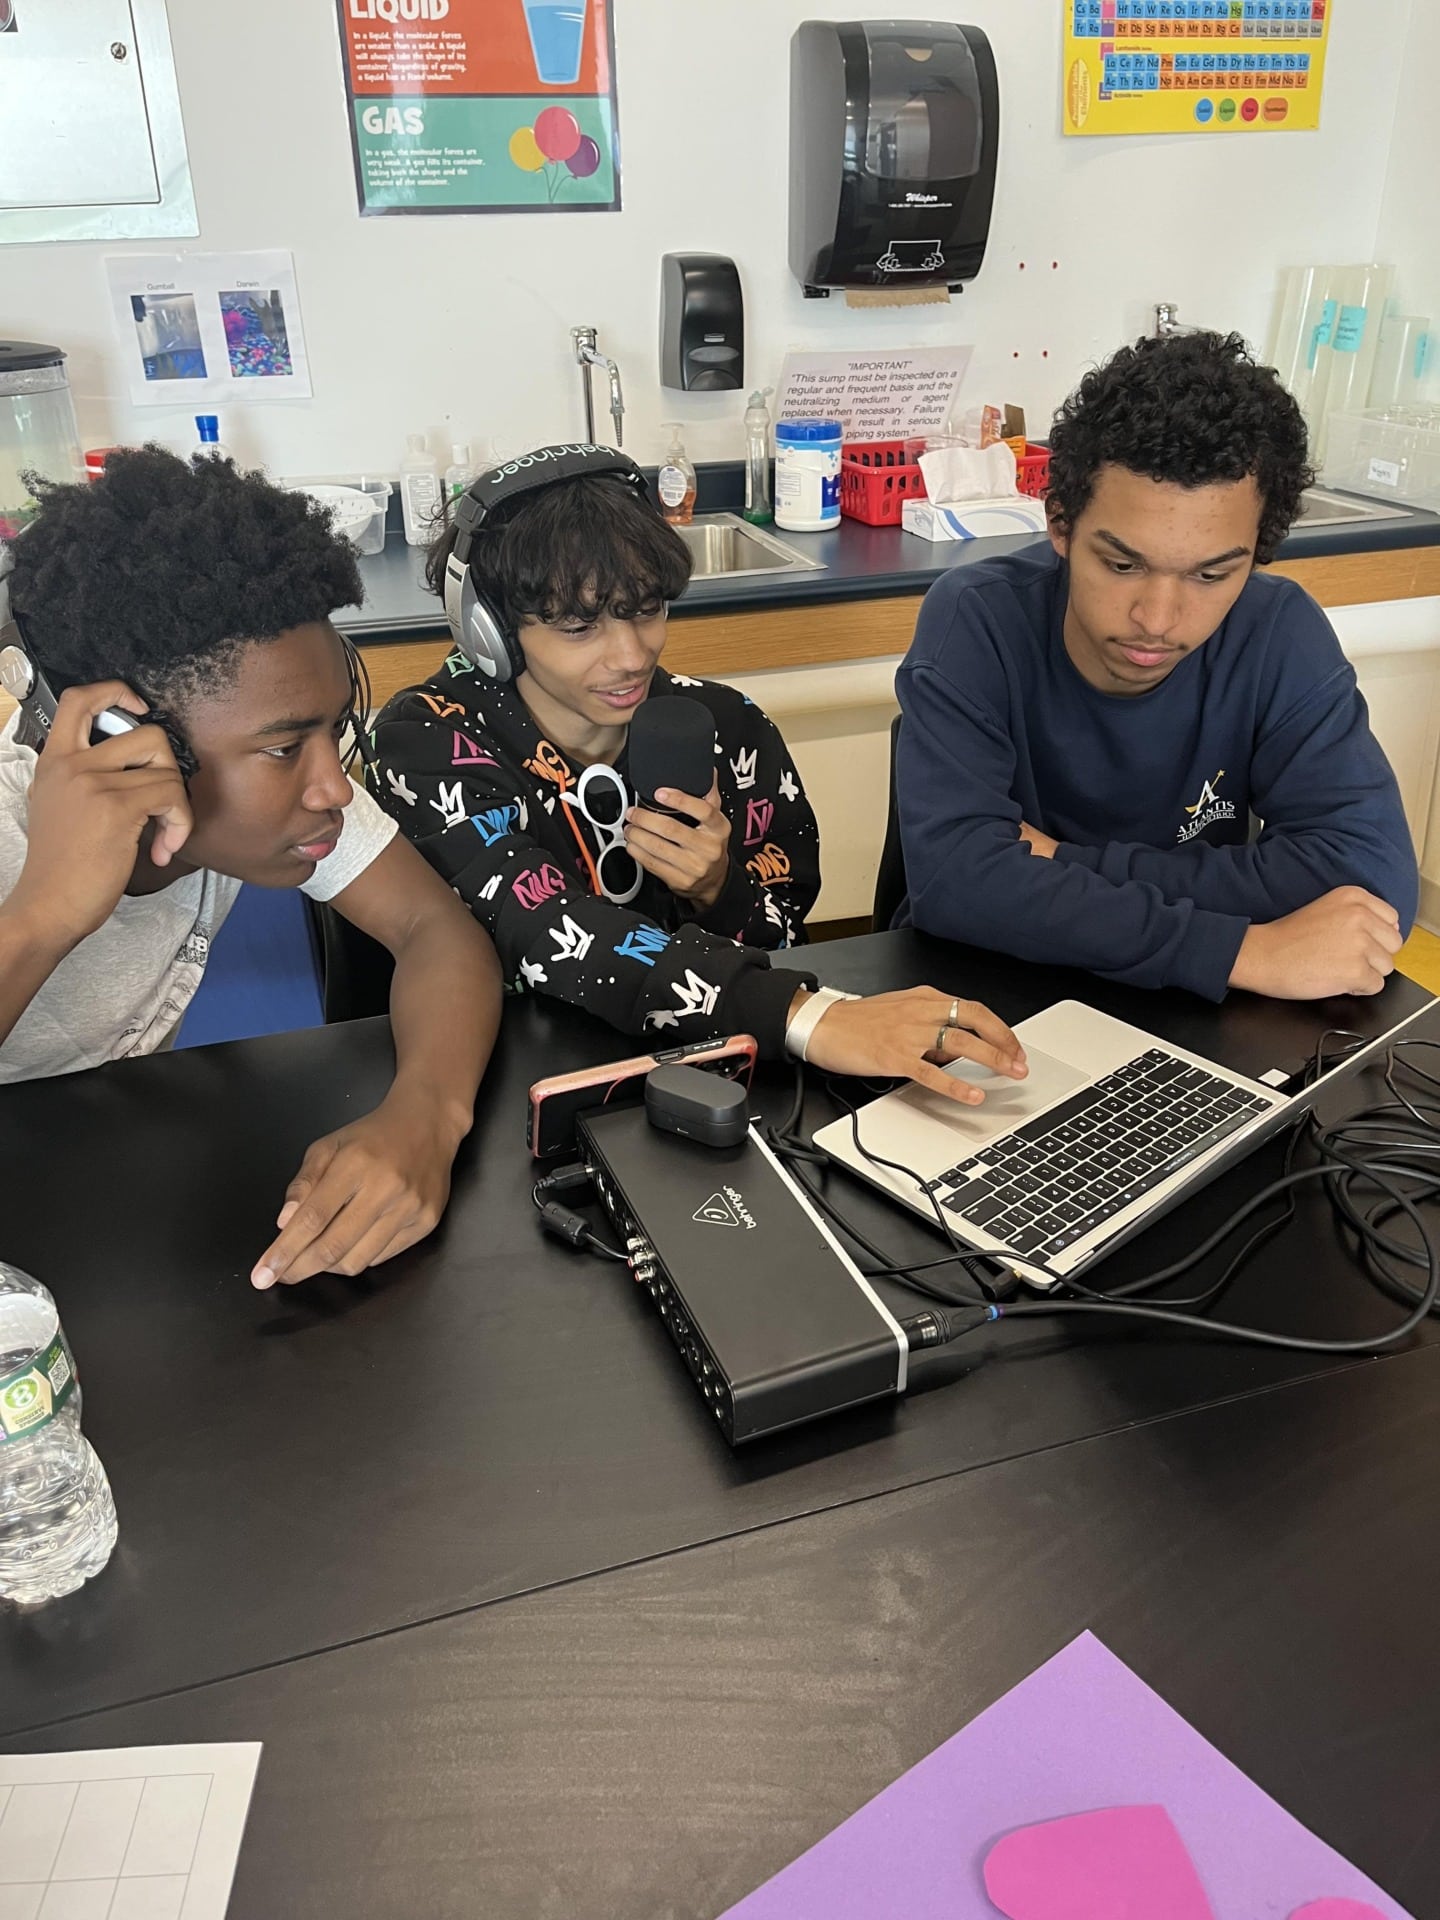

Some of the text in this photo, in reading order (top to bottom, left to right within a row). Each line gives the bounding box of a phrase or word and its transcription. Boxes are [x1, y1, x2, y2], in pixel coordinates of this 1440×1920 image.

[349, 0, 450, 23] LIQUID
[362, 105, 425, 135] GAS
[147, 283, 176, 291] Gumball
[236, 280, 260, 288] Darwin
[818, 374, 846, 384] sump
[848, 373, 872, 382] must
[874, 371, 887, 381] be
[889, 371, 934, 382] inspected
[936, 371, 948, 379] on
[950, 371, 957, 379] a
[787, 381, 953, 396] regular and frequent basis and the
[784, 393, 950, 407] neutralizing medium or agent
[781, 404, 945, 418] replaced when necessary. Failure
[858, 417, 885, 426] result
[892, 417, 900, 426] in
[907, 416, 941, 425] serious
[845, 428, 874, 440] piping
[490, 443, 616, 485] behringer
[723, 1185, 757, 1230] behringer
